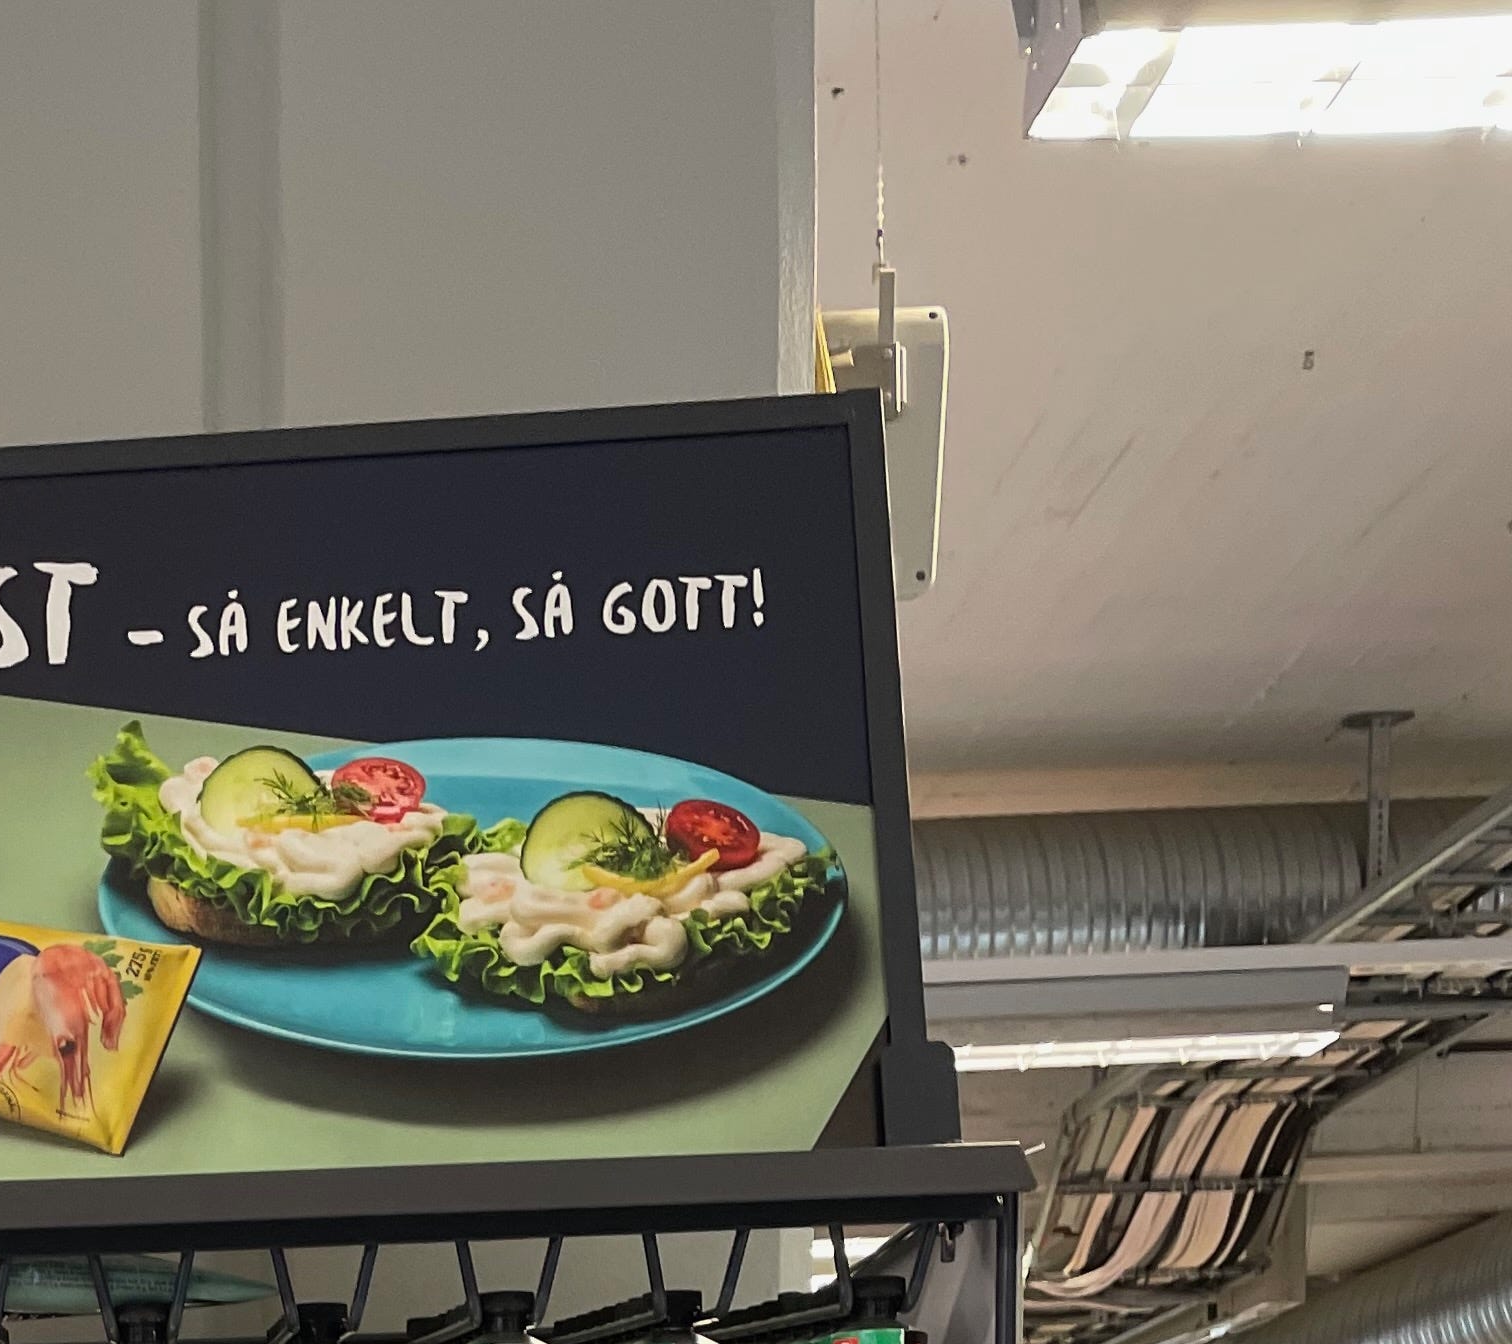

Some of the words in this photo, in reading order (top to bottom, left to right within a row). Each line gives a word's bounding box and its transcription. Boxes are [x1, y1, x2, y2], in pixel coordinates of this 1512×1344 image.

[188, 589, 249, 658] SÅ
[276, 589, 490, 653] ENKELT,
[511, 570, 575, 641] SÅ
[602, 567, 765, 635] GOTT!
